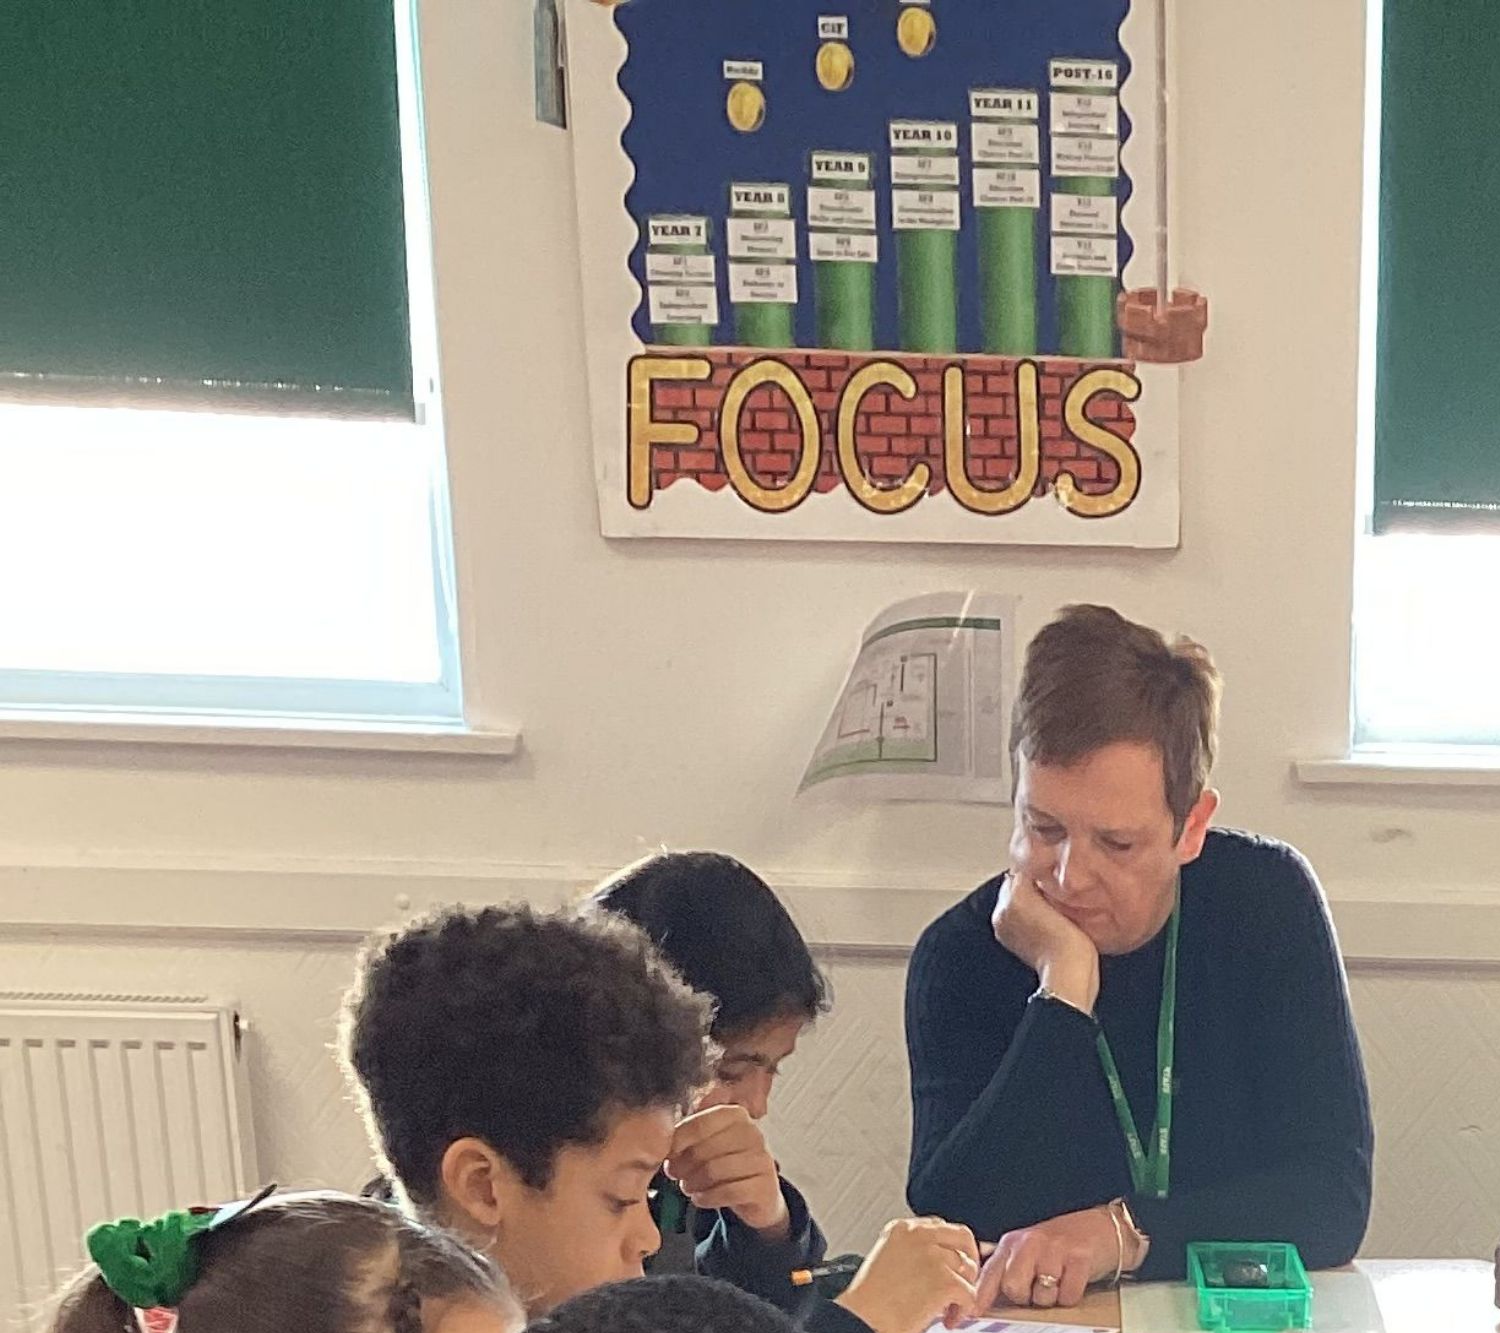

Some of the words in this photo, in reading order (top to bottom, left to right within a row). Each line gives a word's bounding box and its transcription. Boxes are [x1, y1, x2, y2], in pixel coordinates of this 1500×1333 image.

[1053, 67, 1113, 80] POST-16
[974, 98, 1012, 109] YEAR
[1017, 99, 1032, 110] 11
[893, 129, 932, 141] YEAR
[936, 130, 952, 141] 10
[815, 161, 854, 173] YEAR
[858, 162, 866, 173] 9
[734, 191, 774, 203] YEAR
[652, 225, 691, 236] YEAR
[626, 353, 1142, 518] FOCUS
